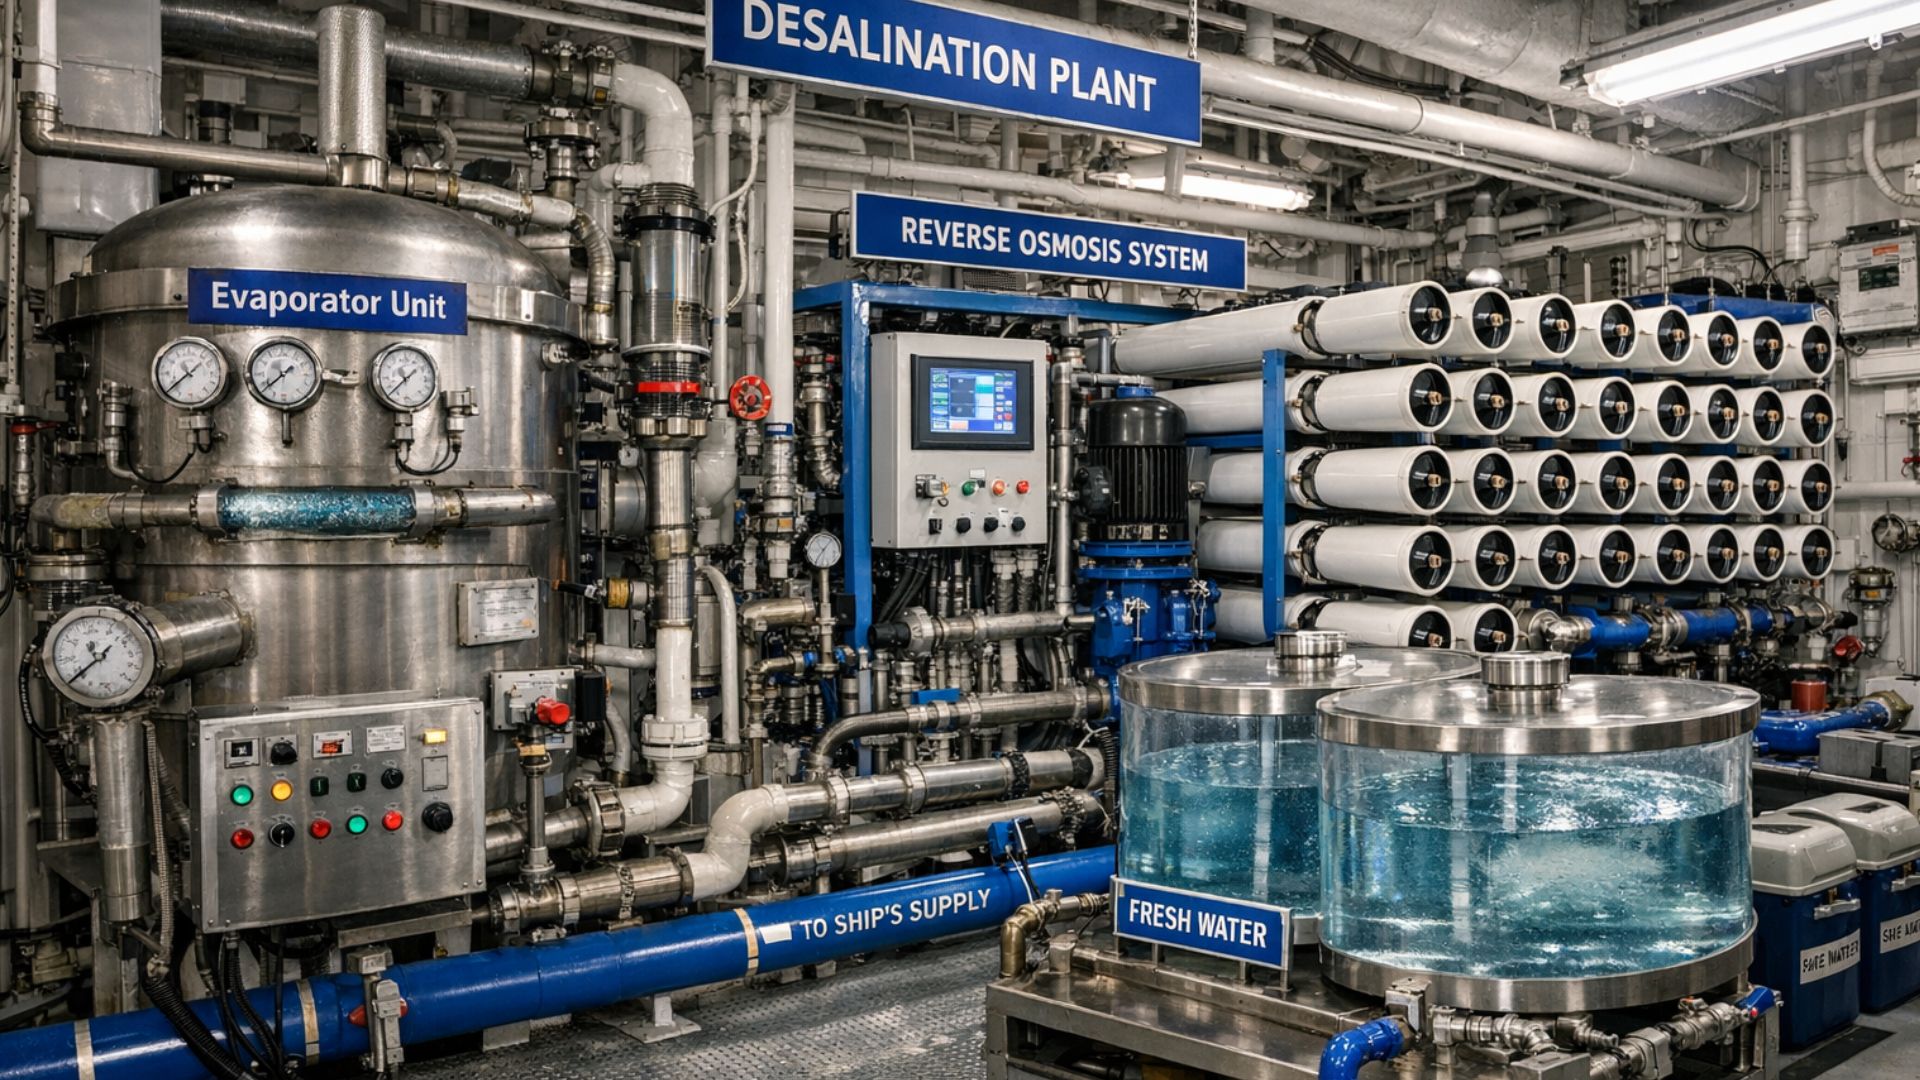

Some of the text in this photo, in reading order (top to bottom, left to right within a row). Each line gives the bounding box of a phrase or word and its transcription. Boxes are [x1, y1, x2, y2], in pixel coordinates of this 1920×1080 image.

[743, 0, 1157, 112] DESALINATION PLANT
[902, 216, 1208, 273] REVERSE OSMOSIS SYSTEM
[212, 281, 447, 319] Evaporator Unit
[798, 888, 991, 940] TO SHIP'S SUPPLY
[1129, 898, 1267, 948] FRESH WATER
